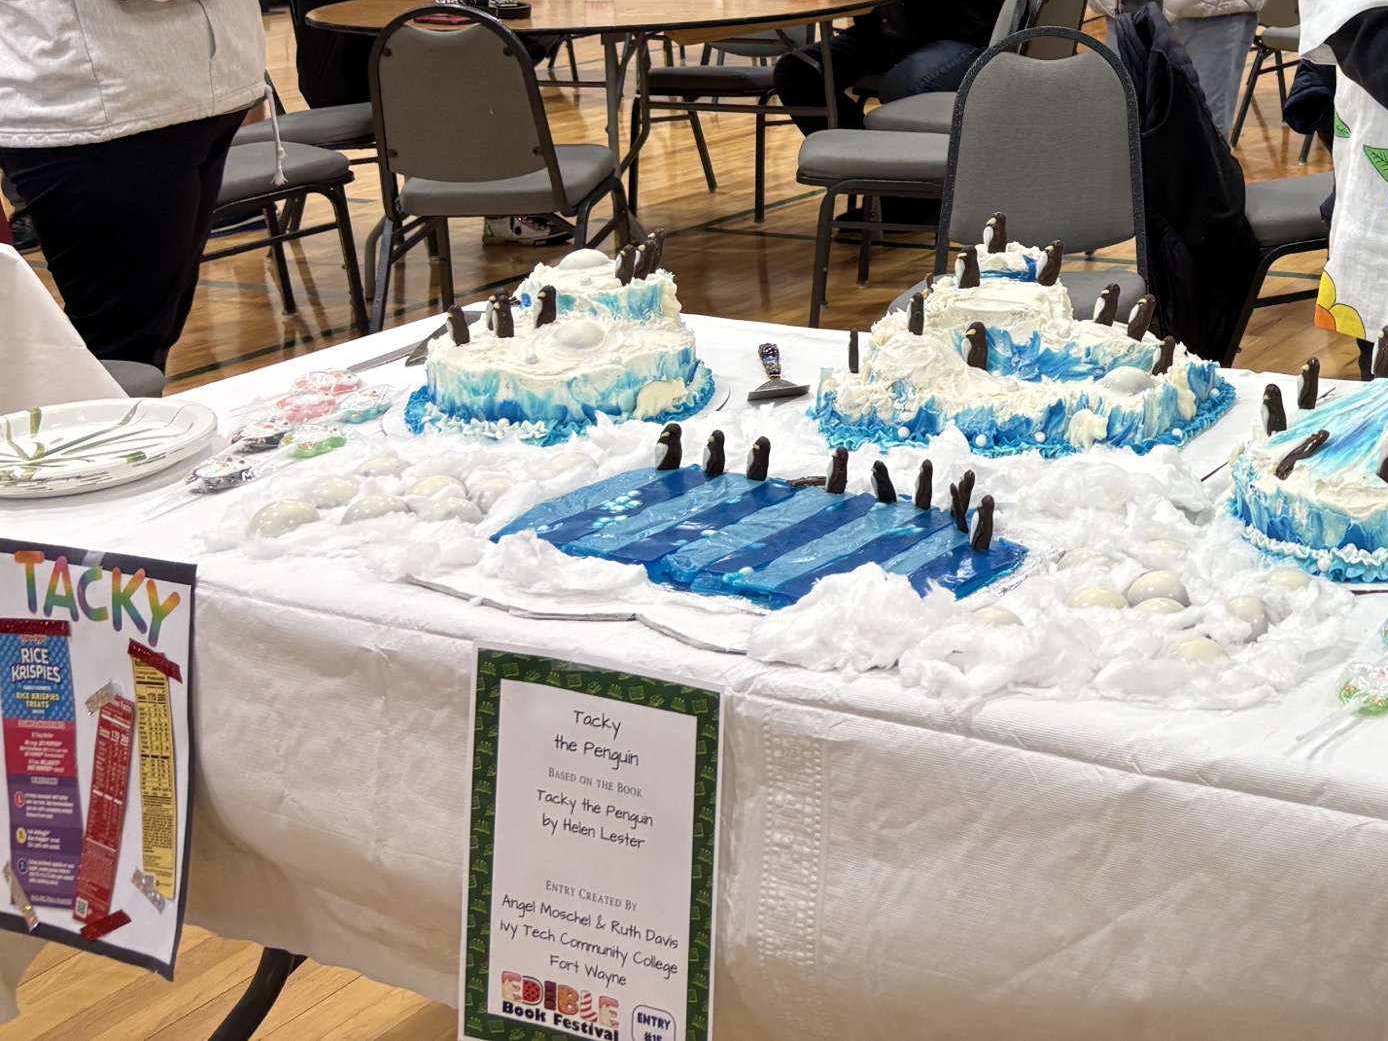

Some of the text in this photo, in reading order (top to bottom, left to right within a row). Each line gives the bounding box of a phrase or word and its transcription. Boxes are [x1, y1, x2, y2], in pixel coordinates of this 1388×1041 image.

[14, 550, 181, 648] TACKY
[11, 664, 61, 683] KRISPIES
[20, 647, 50, 664] RICE
[573, 709, 621, 741] Tacky
[554, 734, 639, 770] the Penguin
[537, 789, 653, 829] Tacky the Penguin
[542, 812, 645, 849] by Helen Lester
[501, 894, 679, 949] Angel Moschel & Ruth Davis
[500, 919, 678, 980] Ivy Tech Community College
[550, 954, 627, 988] Fort Wayne
[501, 970, 619, 1029] EDIBLE
[502, 1000, 619, 1041] Book Festival
[637, 1012, 671, 1030] ENTRY
